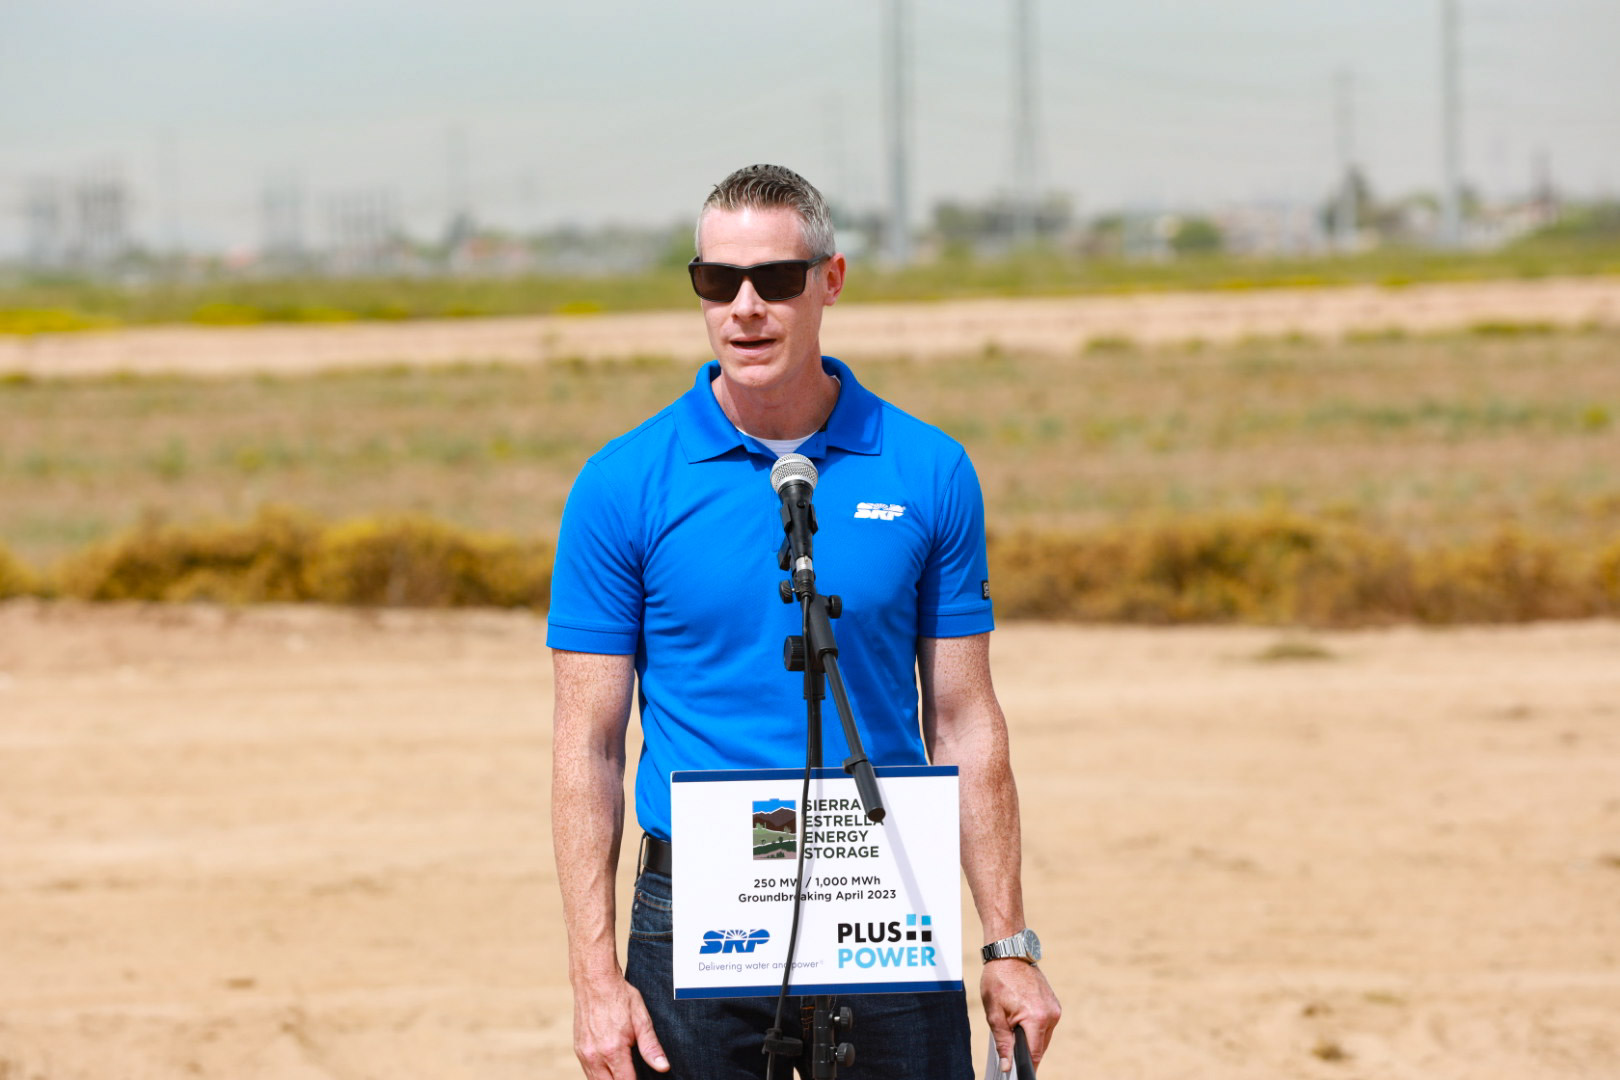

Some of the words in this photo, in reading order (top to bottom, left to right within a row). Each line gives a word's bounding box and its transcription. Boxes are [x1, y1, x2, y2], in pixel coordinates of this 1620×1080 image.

[854, 502, 905, 521] SRP
[804, 798, 861, 811] SIERRA
[803, 830, 869, 843] ENERGY
[803, 846, 880, 859] STORAGE
[753, 878, 776, 888] 250
[815, 876, 848, 888] 1,000
[851, 876, 881, 886] MWh
[738, 890, 832, 903] Groundbraking
[835, 890, 864, 902] April
[867, 889, 897, 900] 2023
[837, 921, 902, 944] PLUS
[699, 928, 771, 955] SRP
[838, 946, 937, 969] POWER
[698, 962, 743, 973] Delivering
[745, 961, 770, 970] water
